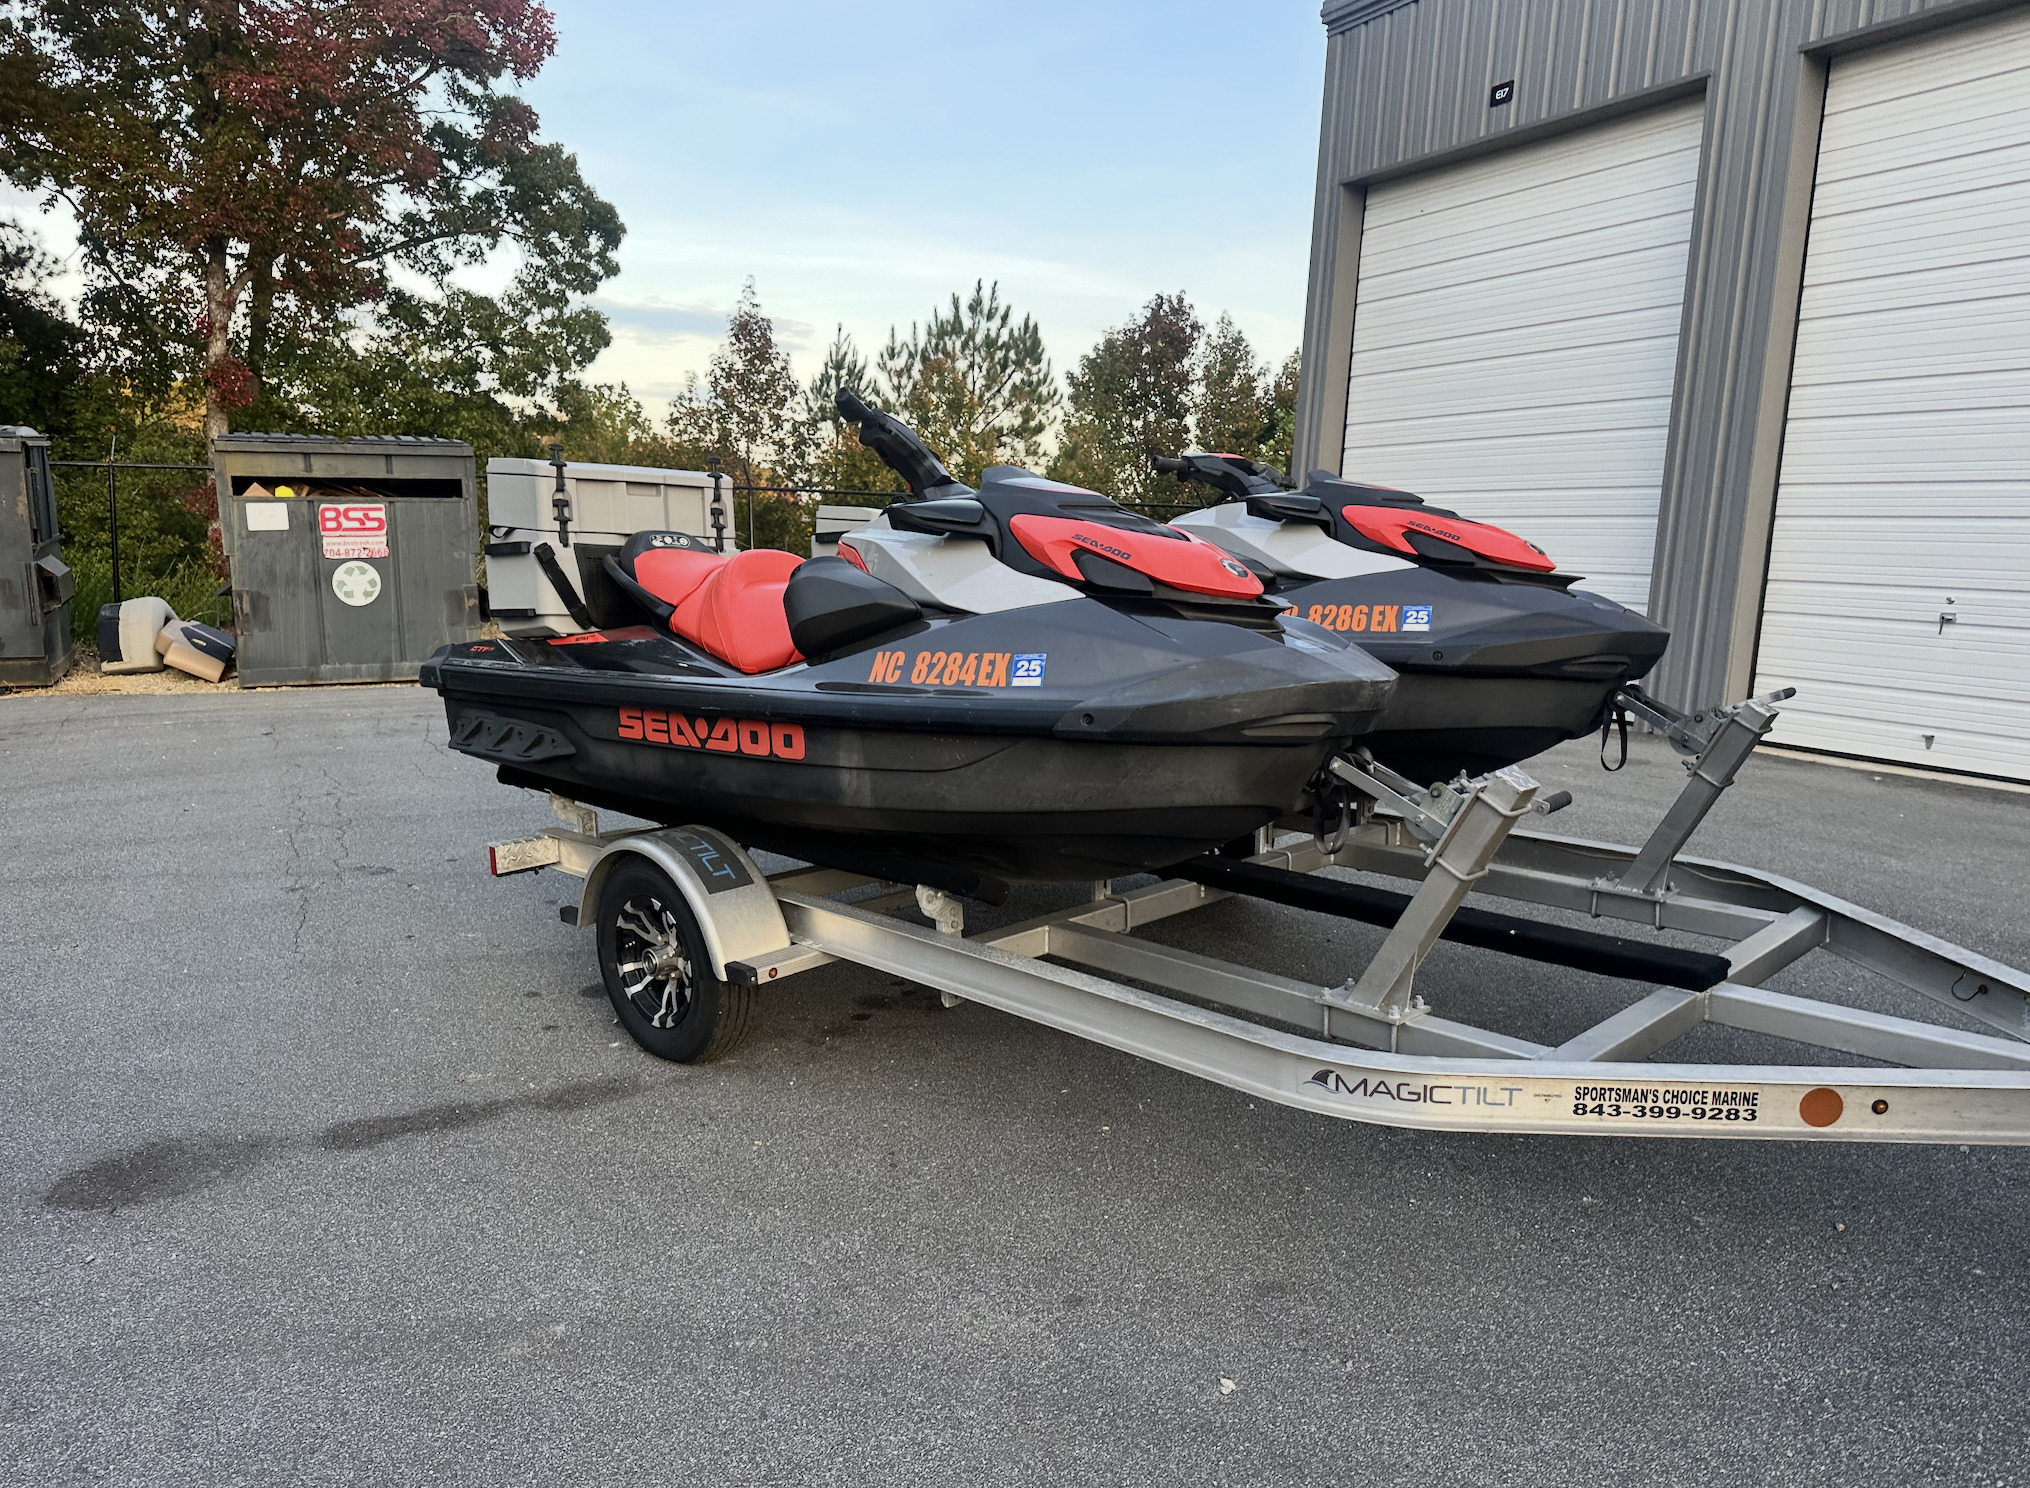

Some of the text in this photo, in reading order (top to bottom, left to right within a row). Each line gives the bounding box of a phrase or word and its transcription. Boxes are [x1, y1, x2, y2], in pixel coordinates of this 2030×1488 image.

[319, 506, 387, 532] BSS
[1405, 610, 1429, 624] 25
[868, 651, 905, 684] NC
[1015, 659, 1042, 677] 25
[1574, 1086, 1759, 1107] SPORTSMAN'S CHOICE MARINE
[1572, 1103, 1758, 1121] 843-399-9283
